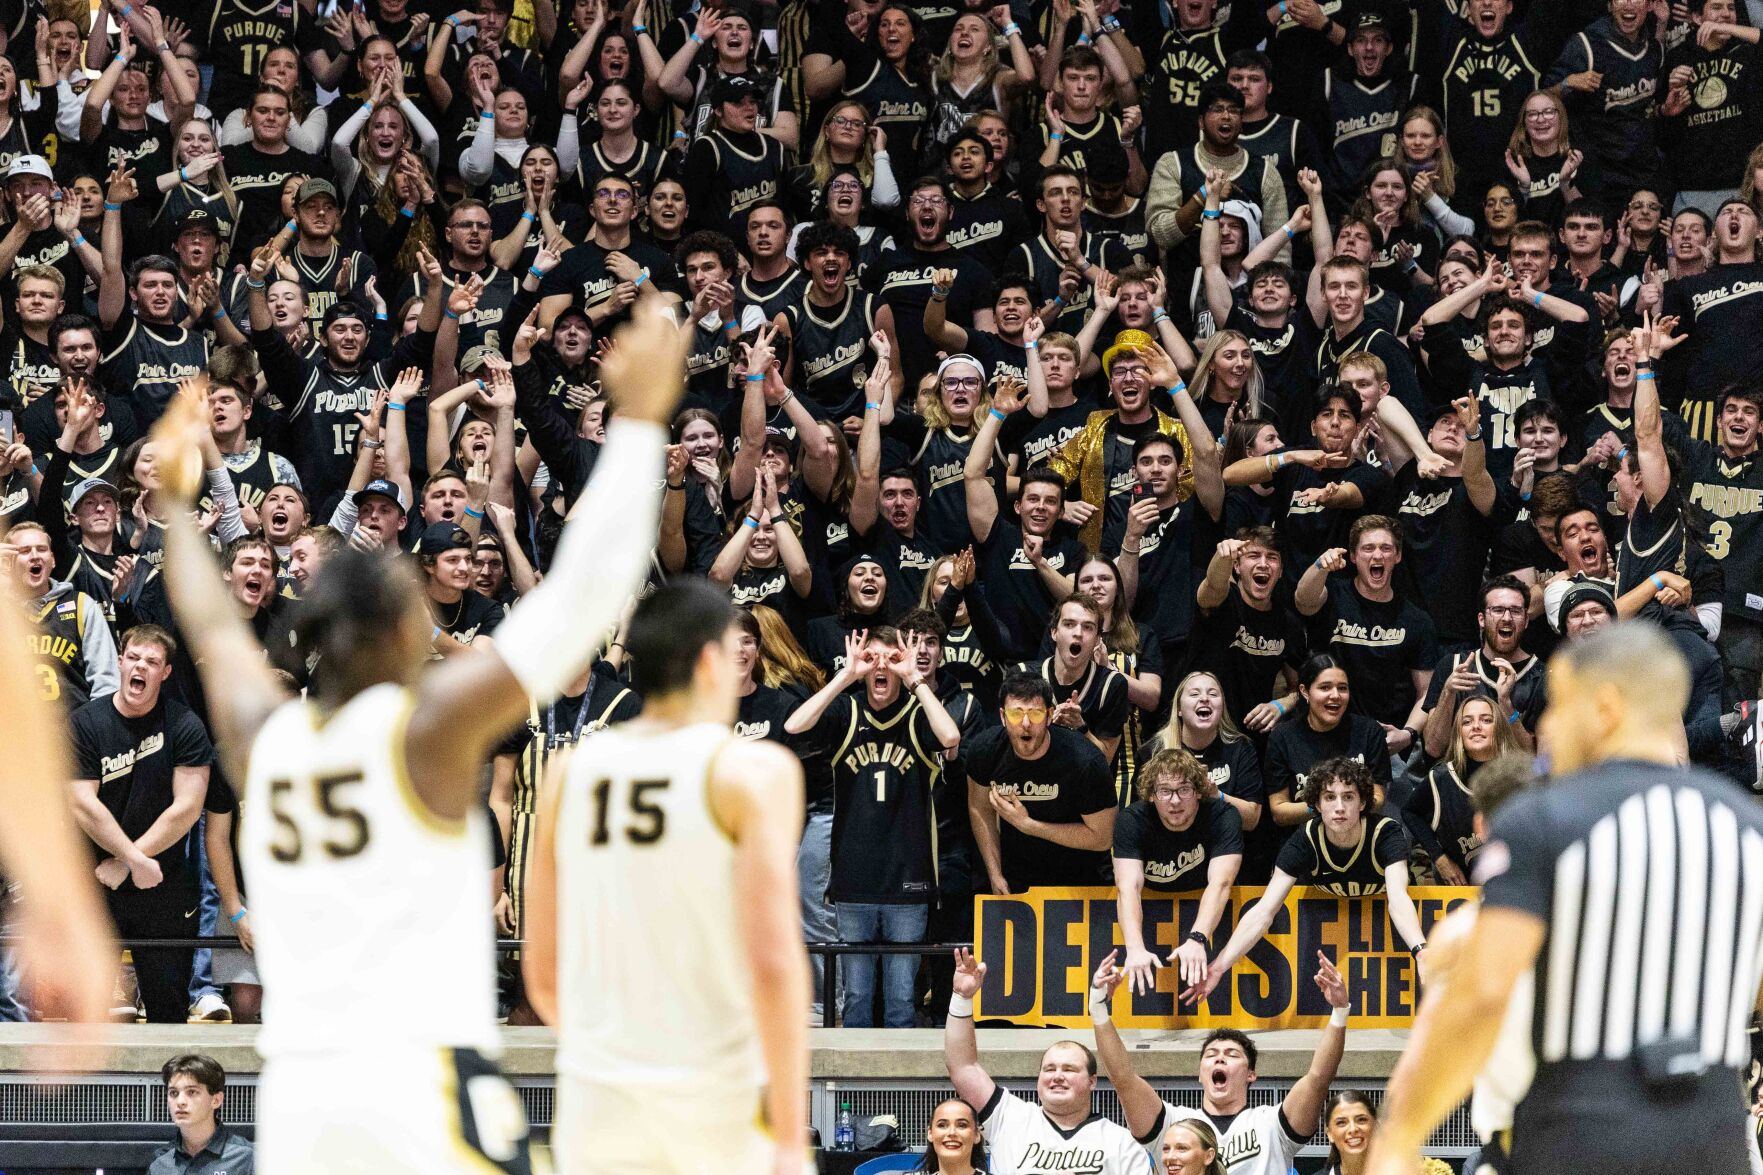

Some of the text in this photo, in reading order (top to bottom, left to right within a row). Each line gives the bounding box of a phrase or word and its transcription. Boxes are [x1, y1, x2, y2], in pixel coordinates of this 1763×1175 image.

[223, 21, 286, 44] PURDUE
[1160, 50, 1219, 82] PURDUE
[1690, 59, 1744, 83] URDUE
[1169, 77, 1200, 107] 55
[1471, 88, 1501, 118] 15
[1605, 83, 1638, 103] Paint
[1336, 110, 1399, 137] Paint Crew
[1687, 107, 1743, 128] ASKETBALL
[42, 133, 59, 168] 3
[1381, 133, 1397, 158] 6
[970, 220, 1003, 238] Crew
[40, 240, 70, 263] Crew
[887, 269, 921, 283] Paint
[1693, 286, 1731, 308] Paint
[472, 308, 503, 324] Crew
[802, 337, 866, 374] Paint Crew
[38, 363, 60, 378] Cre
[137, 363, 168, 380] Paint
[332, 424, 360, 455] 15
[1025, 436, 1057, 460] Paint
[930, 459, 963, 482] Paint
[1110, 470, 1136, 488] aint
[1689, 482, 1763, 519] PURDUE
[827, 523, 848, 537] Cre
[1709, 521, 1733, 560] 3
[1335, 619, 1406, 642] Paint Crew
[1257, 636, 1285, 655] Cew
[942, 646, 995, 678] RDUE
[734, 720, 771, 739] Crew
[101, 732, 164, 776] Paint rew
[845, 742, 915, 775] PURDUE
[874, 771, 886, 802] 1
[1023, 780, 1059, 802] Crew
[269, 771, 370, 864] 55
[590, 778, 671, 847] 15
[1145, 858, 1177, 878] Paint
[981, 898, 1340, 1017] DEFENSE
[1017, 1143, 1105, 1173] Purdue
